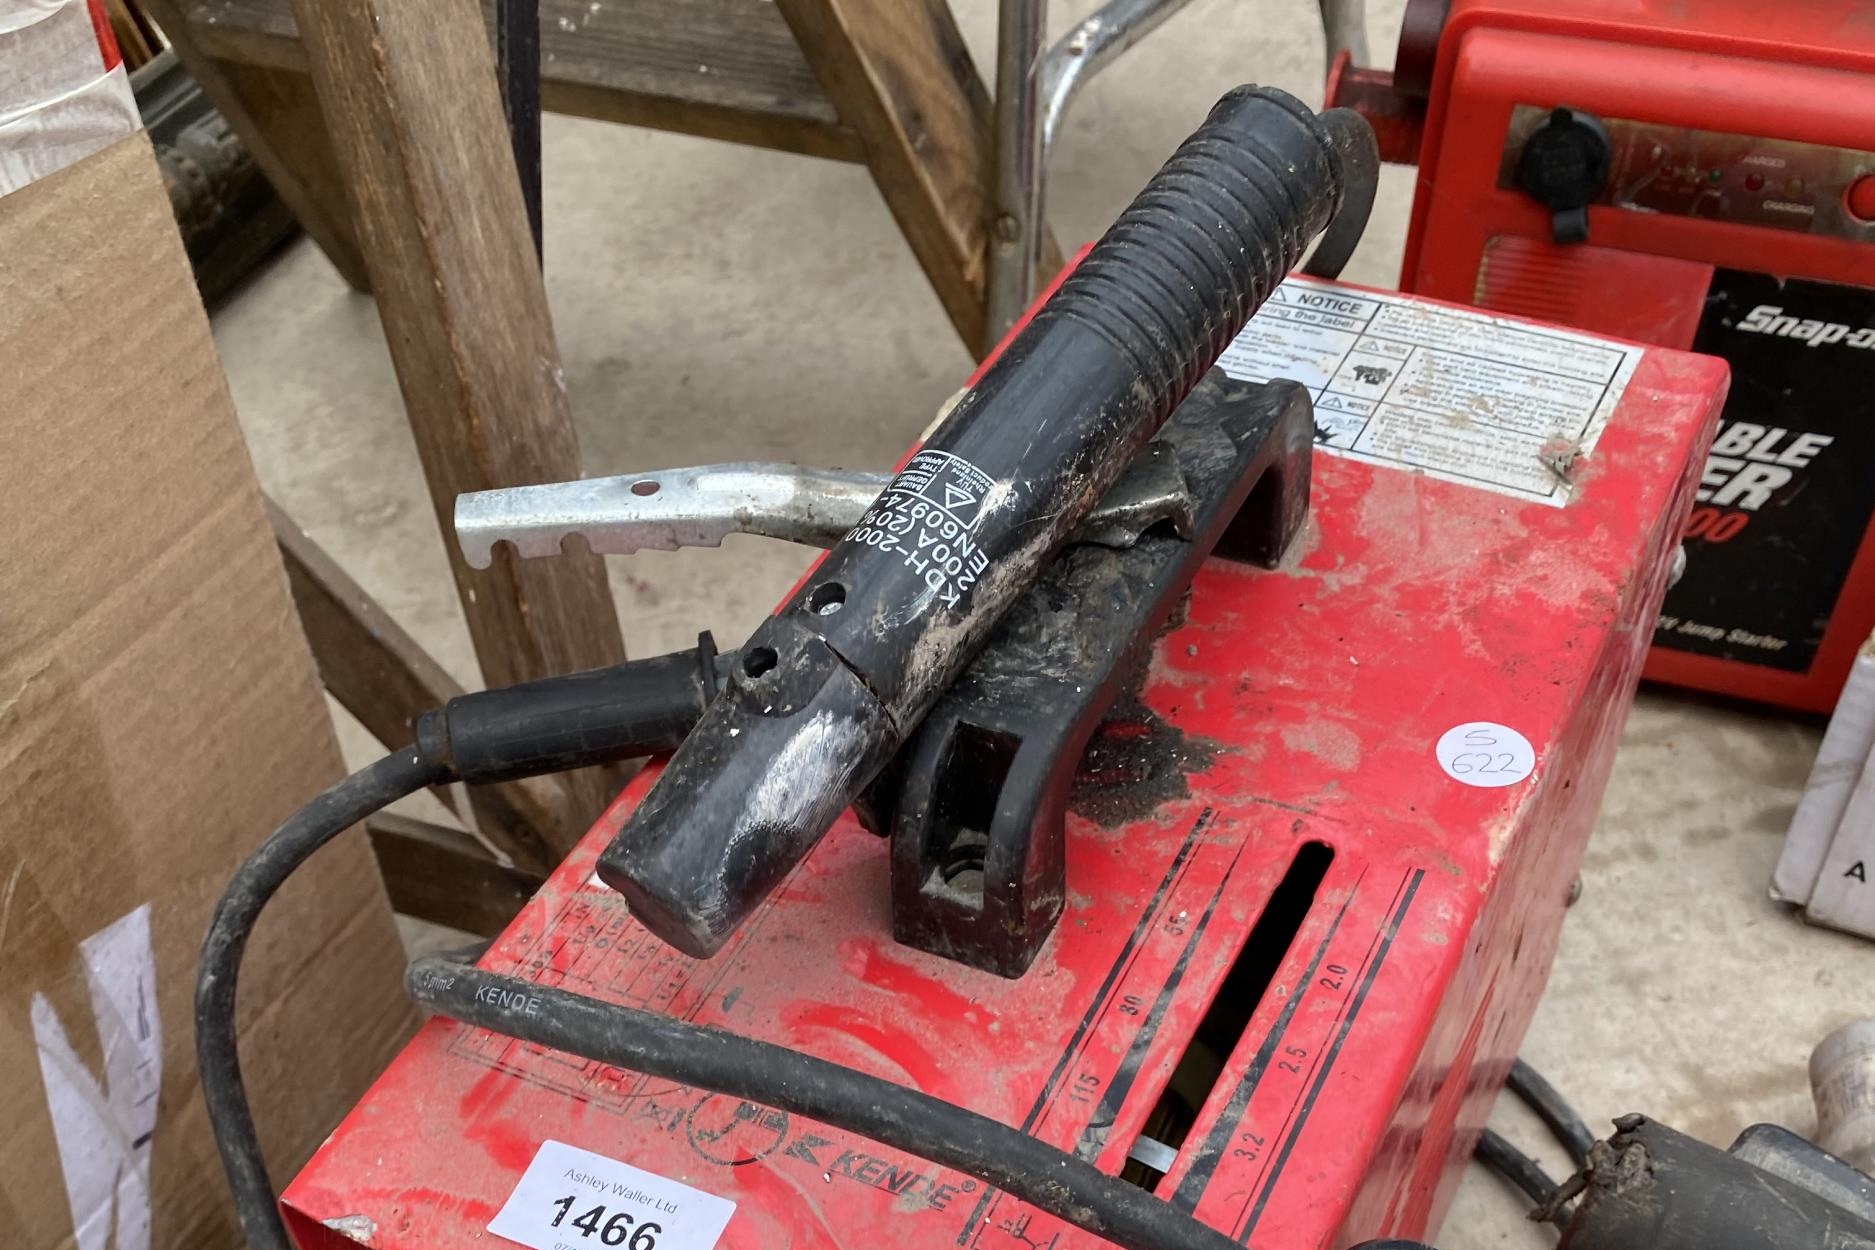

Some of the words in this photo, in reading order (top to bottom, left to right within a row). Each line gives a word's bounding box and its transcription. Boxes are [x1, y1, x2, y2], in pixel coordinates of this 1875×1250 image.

[1297, 293, 1364, 315] NOTICE
[1294, 308, 1317, 322] the
[1317, 313, 1356, 329] label
[1736, 304, 1875, 350] Snap-o
[1710, 419, 1836, 468] BLE
[918, 462, 938, 473] TYPE
[949, 457, 973, 474] Safety
[950, 467, 986, 494] Rheinland
[971, 470, 995, 490] roduct
[845, 527, 960, 610] KDH-2000
[917, 528, 976, 592] 200A
[1677, 620, 1725, 642] Jump
[1452, 752, 1522, 774] 622
[1842, 861, 1867, 883] A
[1320, 964, 1348, 991] 2.0
[1278, 1046, 1308, 1074] 2.5
[1069, 1073, 1101, 1104] 115
[1234, 1132, 1265, 1161] 3.2
[563, 1168, 608, 1193] Ashley
[611, 1181, 655, 1207] Waller
[655, 1198, 679, 1214] Ltd
